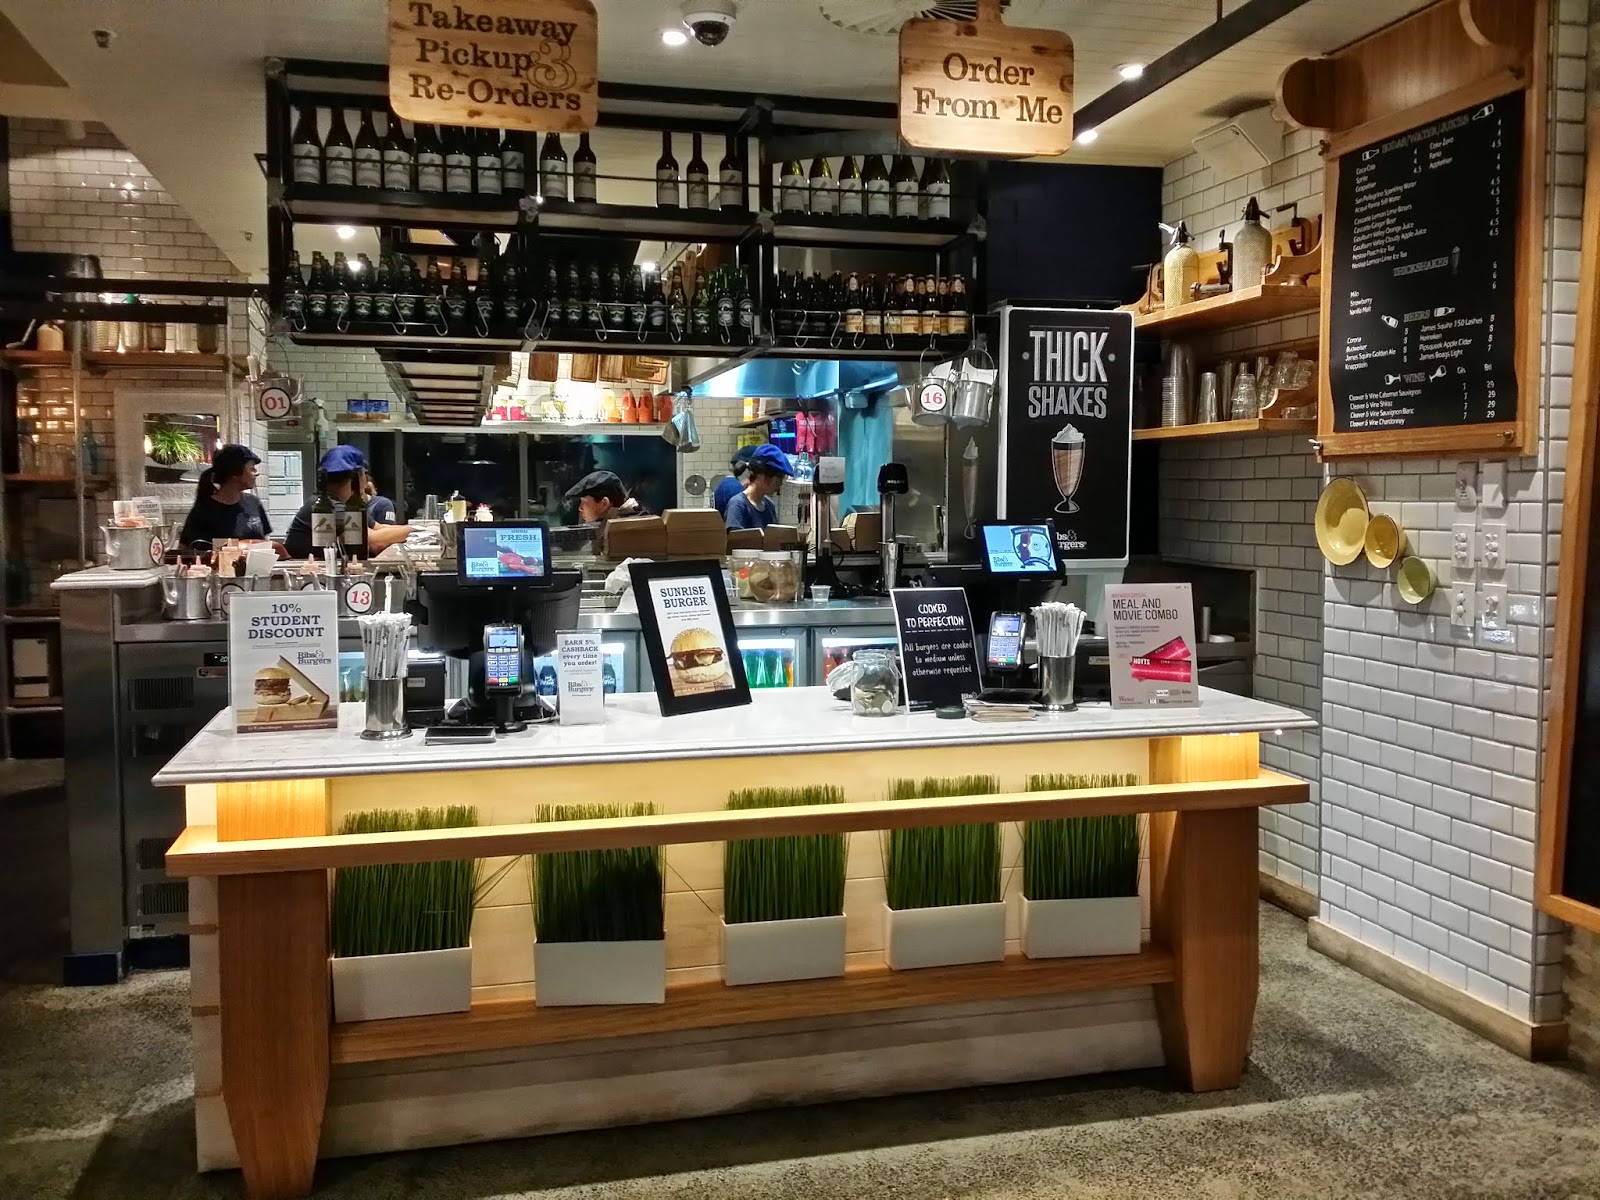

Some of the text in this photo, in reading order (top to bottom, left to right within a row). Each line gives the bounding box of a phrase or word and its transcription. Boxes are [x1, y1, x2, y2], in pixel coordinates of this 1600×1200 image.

[408, 2, 578, 46] Takeaway
[416, 37, 533, 78] Pickup
[942, 52, 1035, 86] Order
[408, 73, 582, 111] Re-Orders
[912, 86, 1063, 124] From Me
[1029, 331, 1109, 382] THICK
[1402, 372, 1426, 383] WINE
[1486, 380, 1495, 389] 29
[924, 392, 943, 405] 16
[1487, 390, 1496, 399] 29
[265, 396, 287, 410] 01
[1028, 385, 1107, 419] SHAKES
[1487, 400, 1496, 408] 29
[1486, 409, 1496, 418] 29
[1057, 541, 1087, 550] rgers
[351, 591, 370, 605] 13
[660, 585, 706, 598] SUNRISE
[271, 603, 302, 614] 10%
[663, 596, 708, 609] BURGER
[917, 603, 948, 614] COOKED
[1112, 598, 1162, 610] MEAL AND
[251, 615, 321, 627] STUDENT
[1113, 608, 1179, 621] MOVIE COMBO
[905, 615, 965, 628] TO PERFECTION
[248, 627, 325, 639] DISCOUNT
[904, 642, 914, 652] All
[915, 643, 940, 655] burgers
[953, 640, 973, 649] cooked
[297, 657, 332, 666] Burgers
[915, 652, 966, 664] to medium unless
[912, 664, 973, 676] otherwise requested
